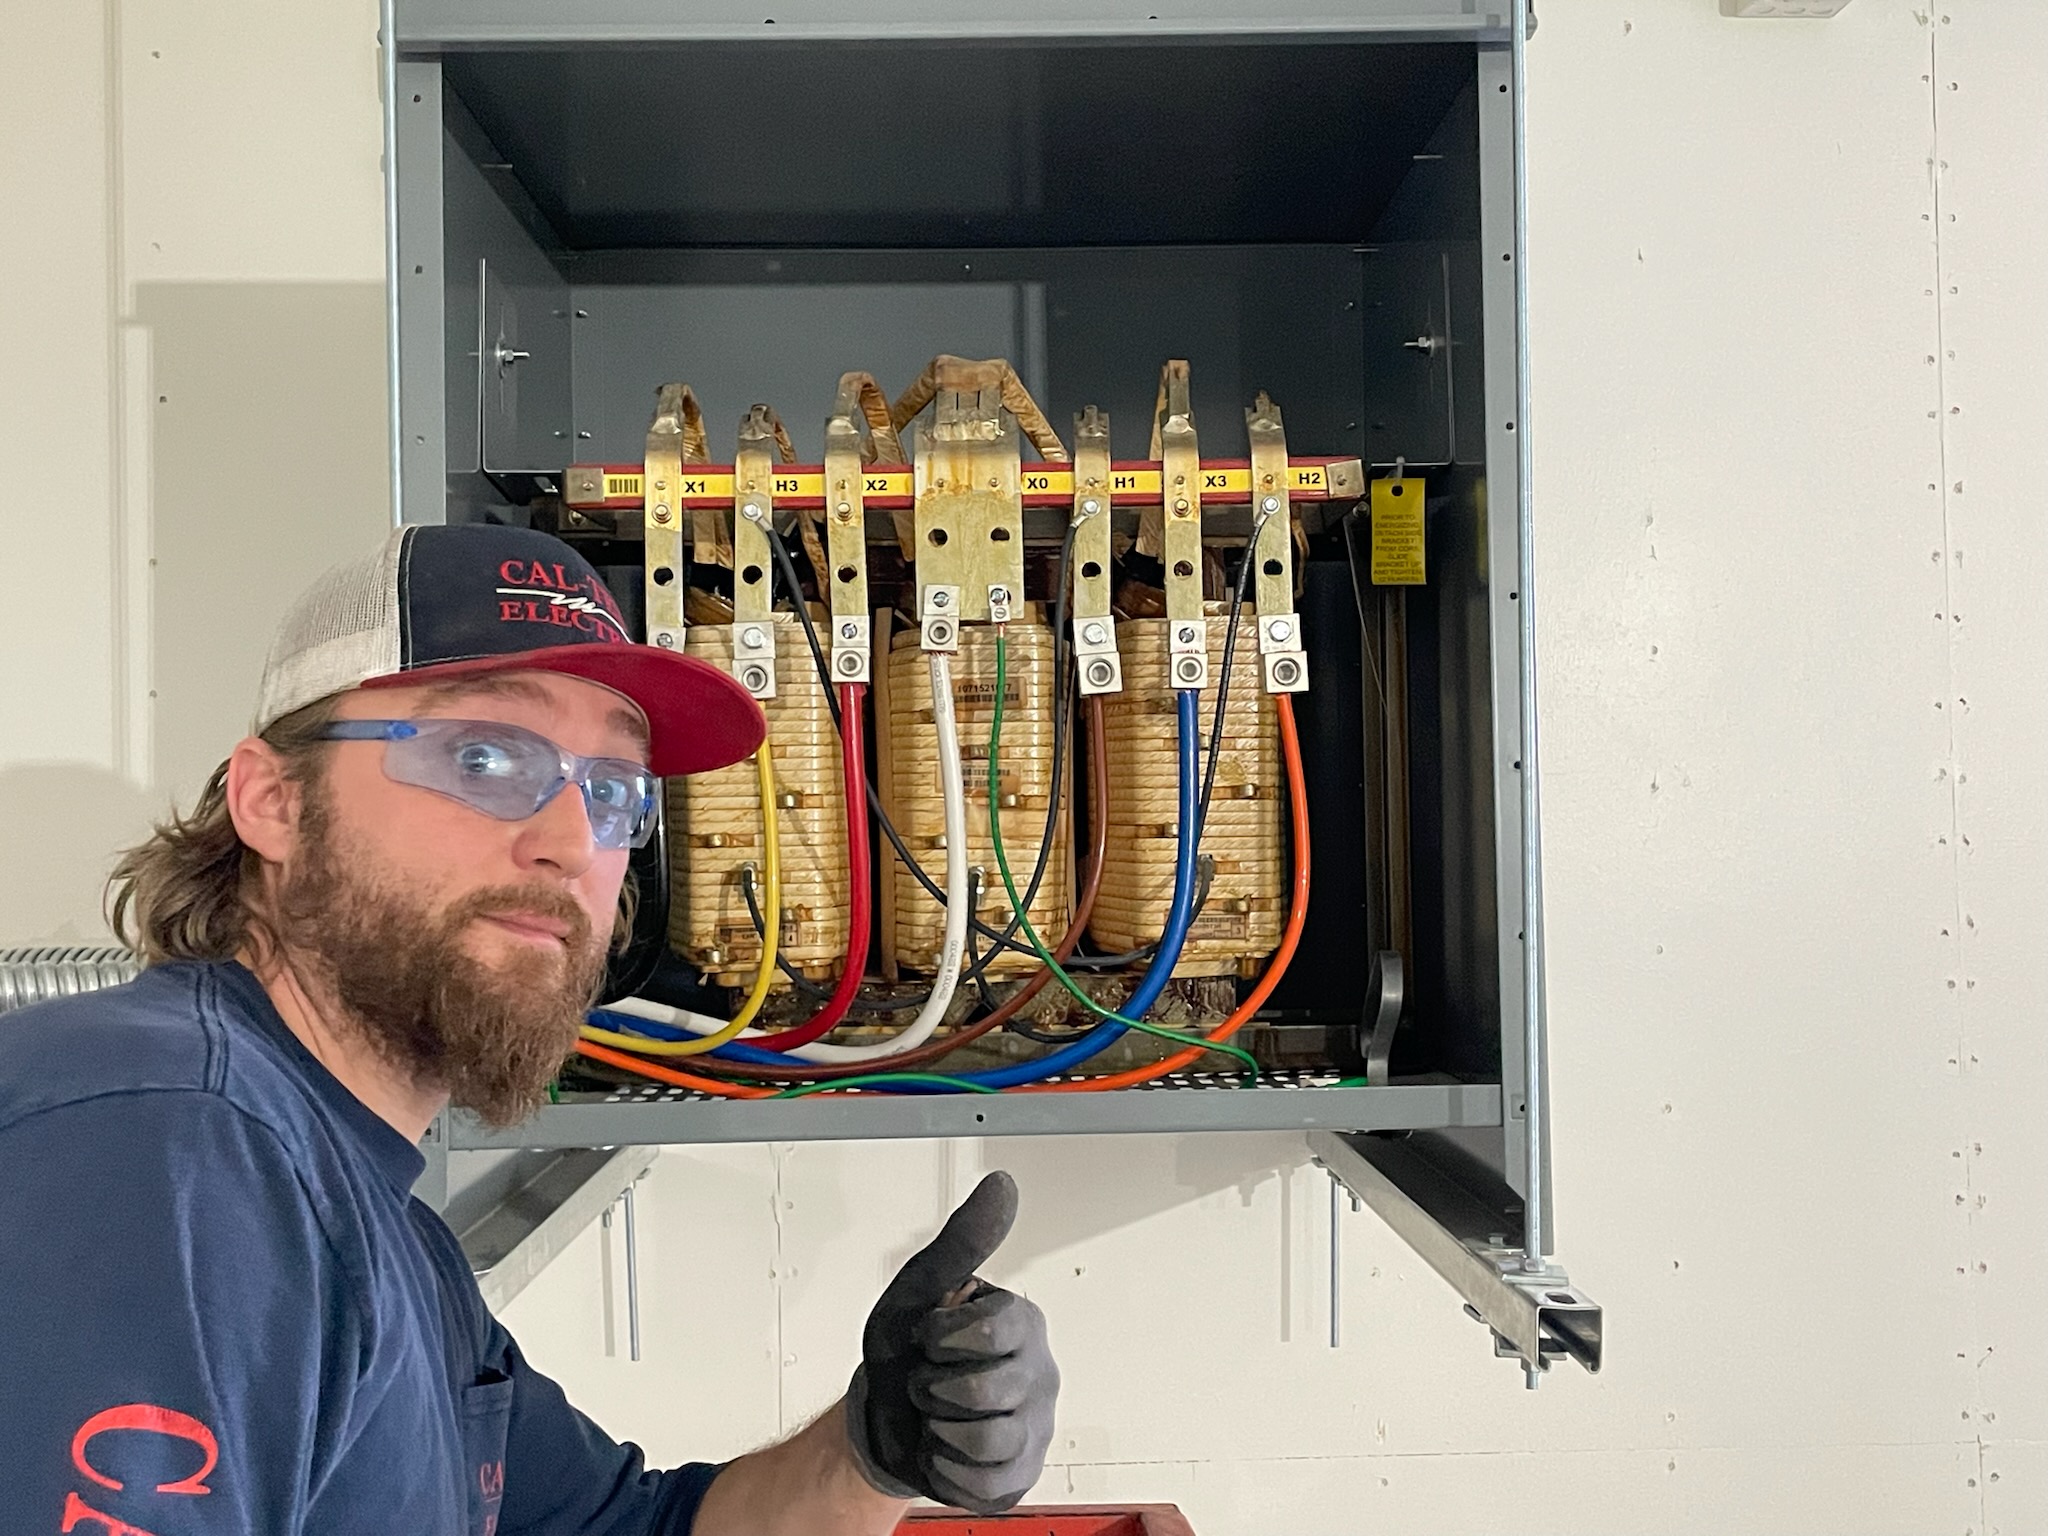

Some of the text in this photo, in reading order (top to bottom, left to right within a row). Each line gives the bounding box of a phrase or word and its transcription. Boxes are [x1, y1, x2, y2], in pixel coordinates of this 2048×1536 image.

[684, 472, 1321, 493] X1 H3 X2 X0 H1 X3 H2
[957, 684, 1012, 693] 10715217
